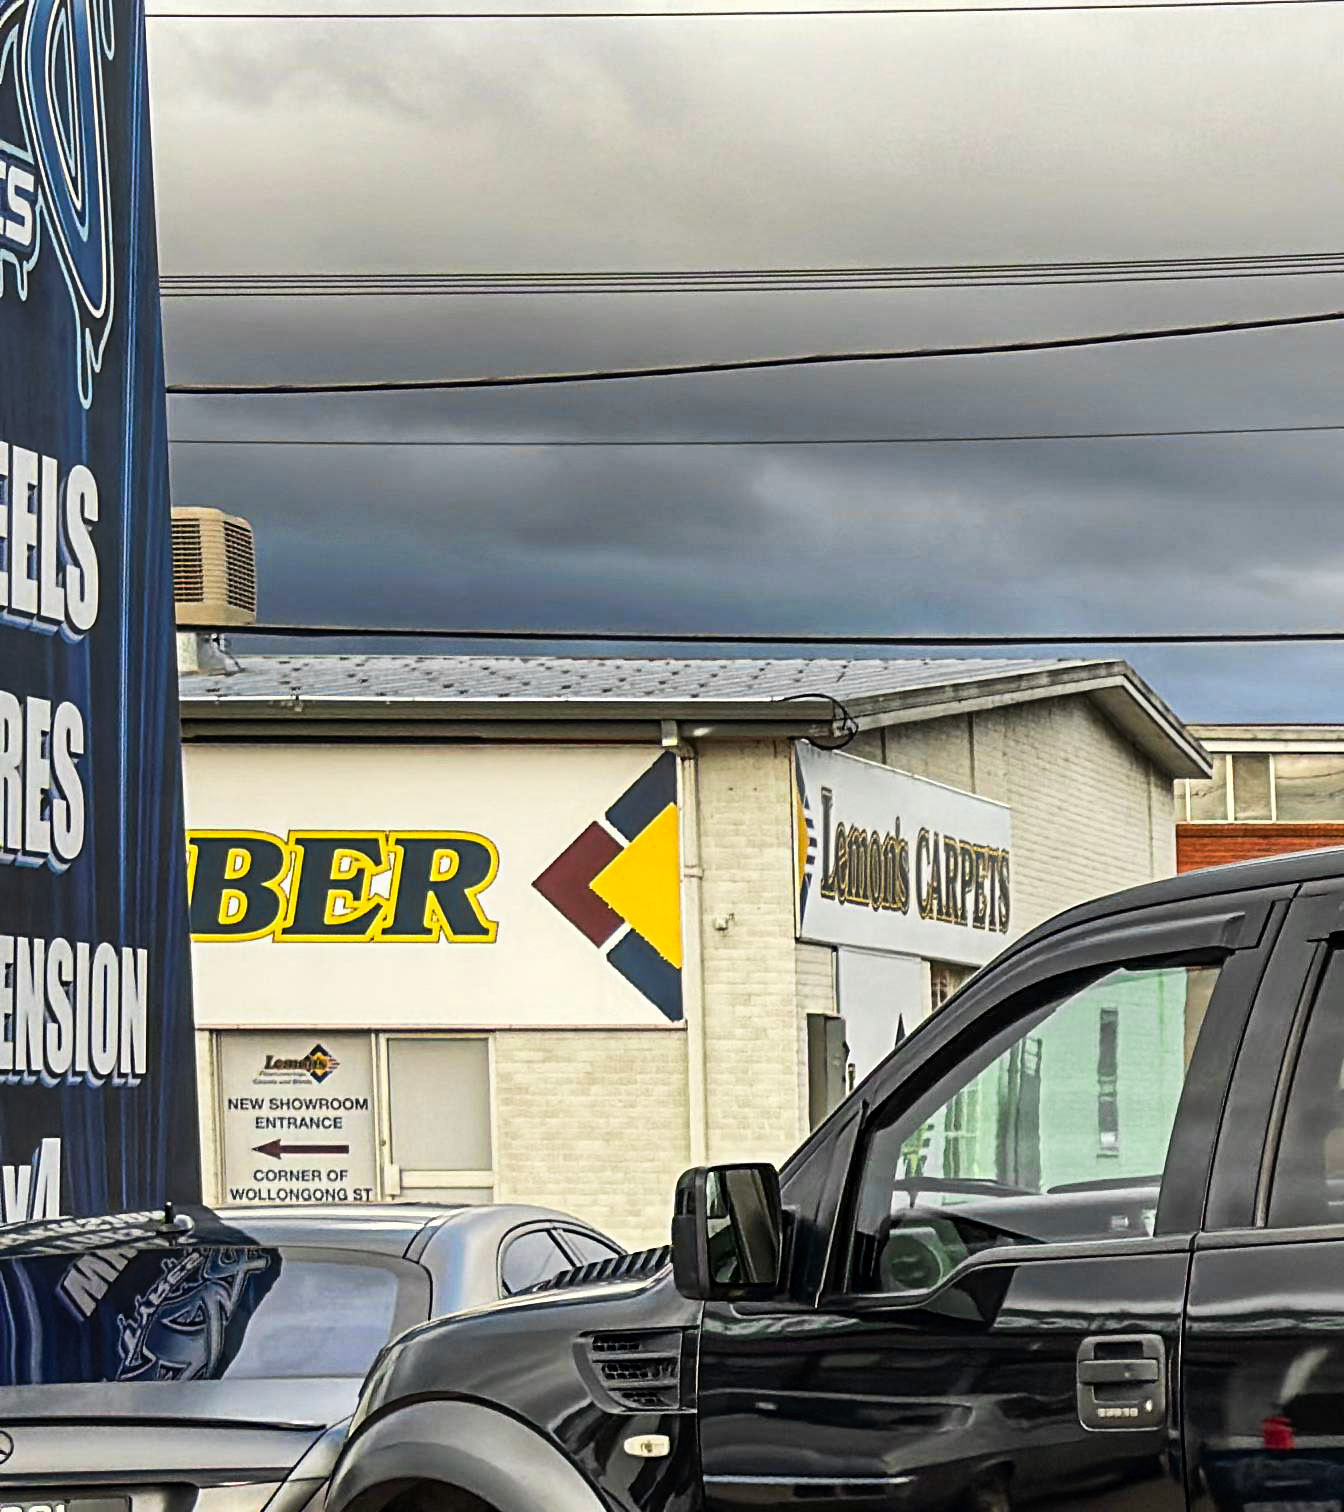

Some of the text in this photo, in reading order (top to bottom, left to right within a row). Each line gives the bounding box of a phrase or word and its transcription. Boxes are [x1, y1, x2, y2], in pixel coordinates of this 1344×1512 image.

[821, 786, 1010, 935] Lemon's CARPETS
[228, 1098, 369, 1111] NEW SHOWROOM
[255, 1117, 343, 1129] ENTRANCE
[253, 1170, 348, 1182] CORNER OF
[230, 1188, 373, 1201] WOLLONGONG ST
